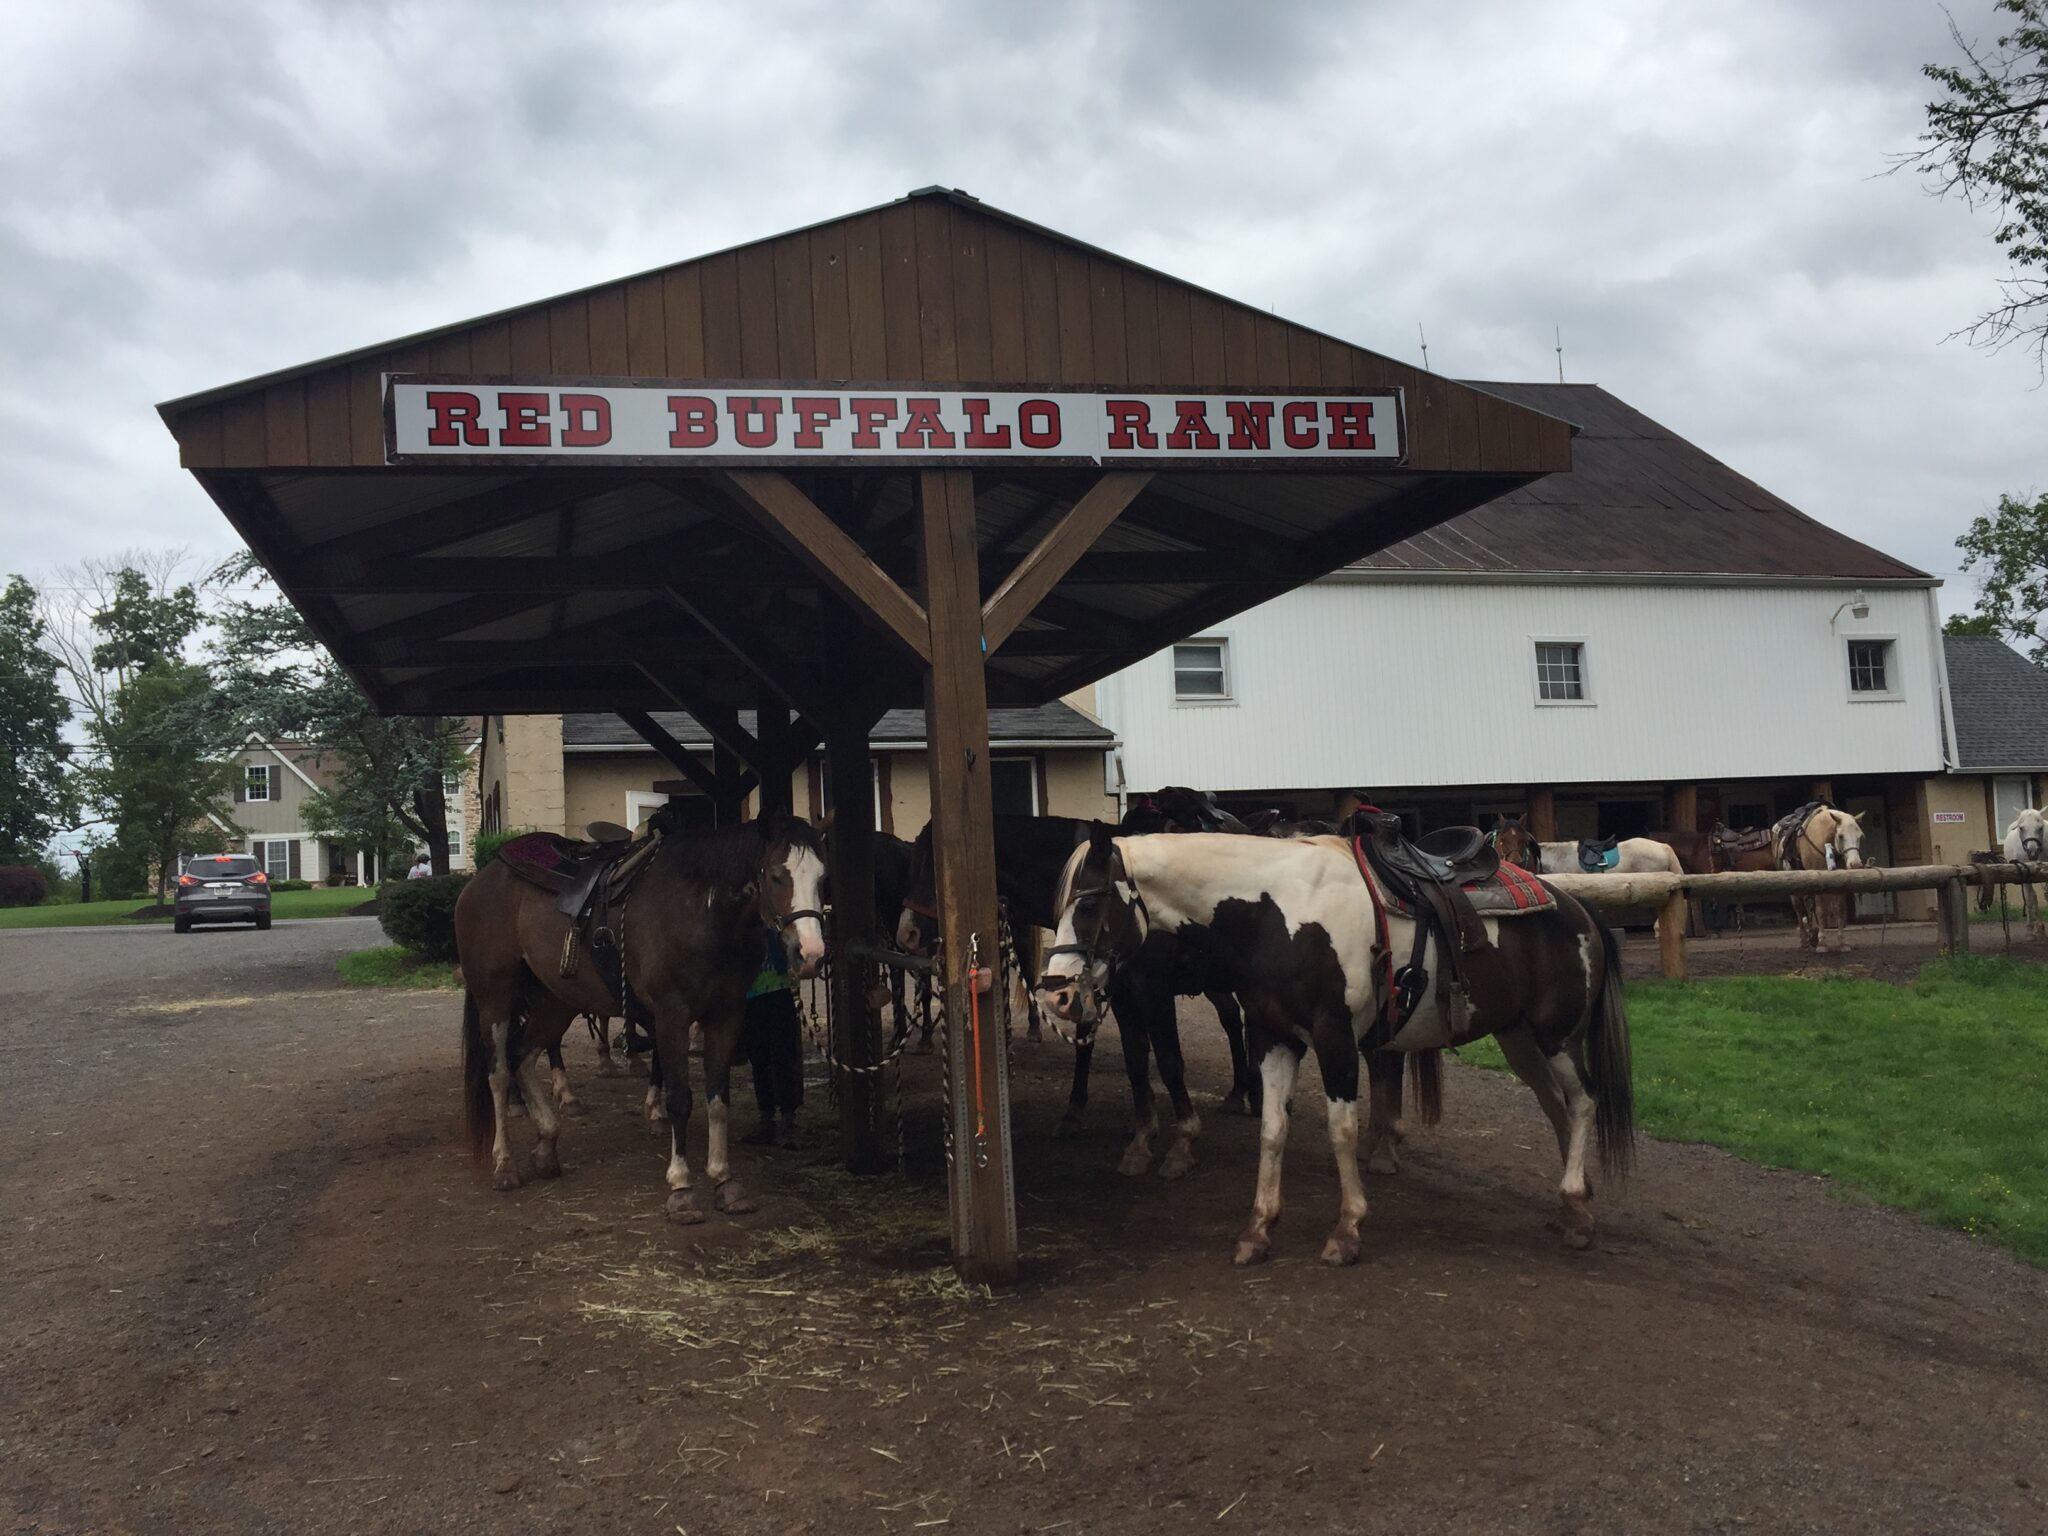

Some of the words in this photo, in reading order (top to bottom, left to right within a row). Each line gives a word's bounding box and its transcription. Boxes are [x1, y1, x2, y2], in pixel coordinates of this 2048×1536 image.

[427, 391, 613, 447] RED
[667, 396, 1062, 450] BUFFALO
[1106, 399, 1375, 450] RANCH
